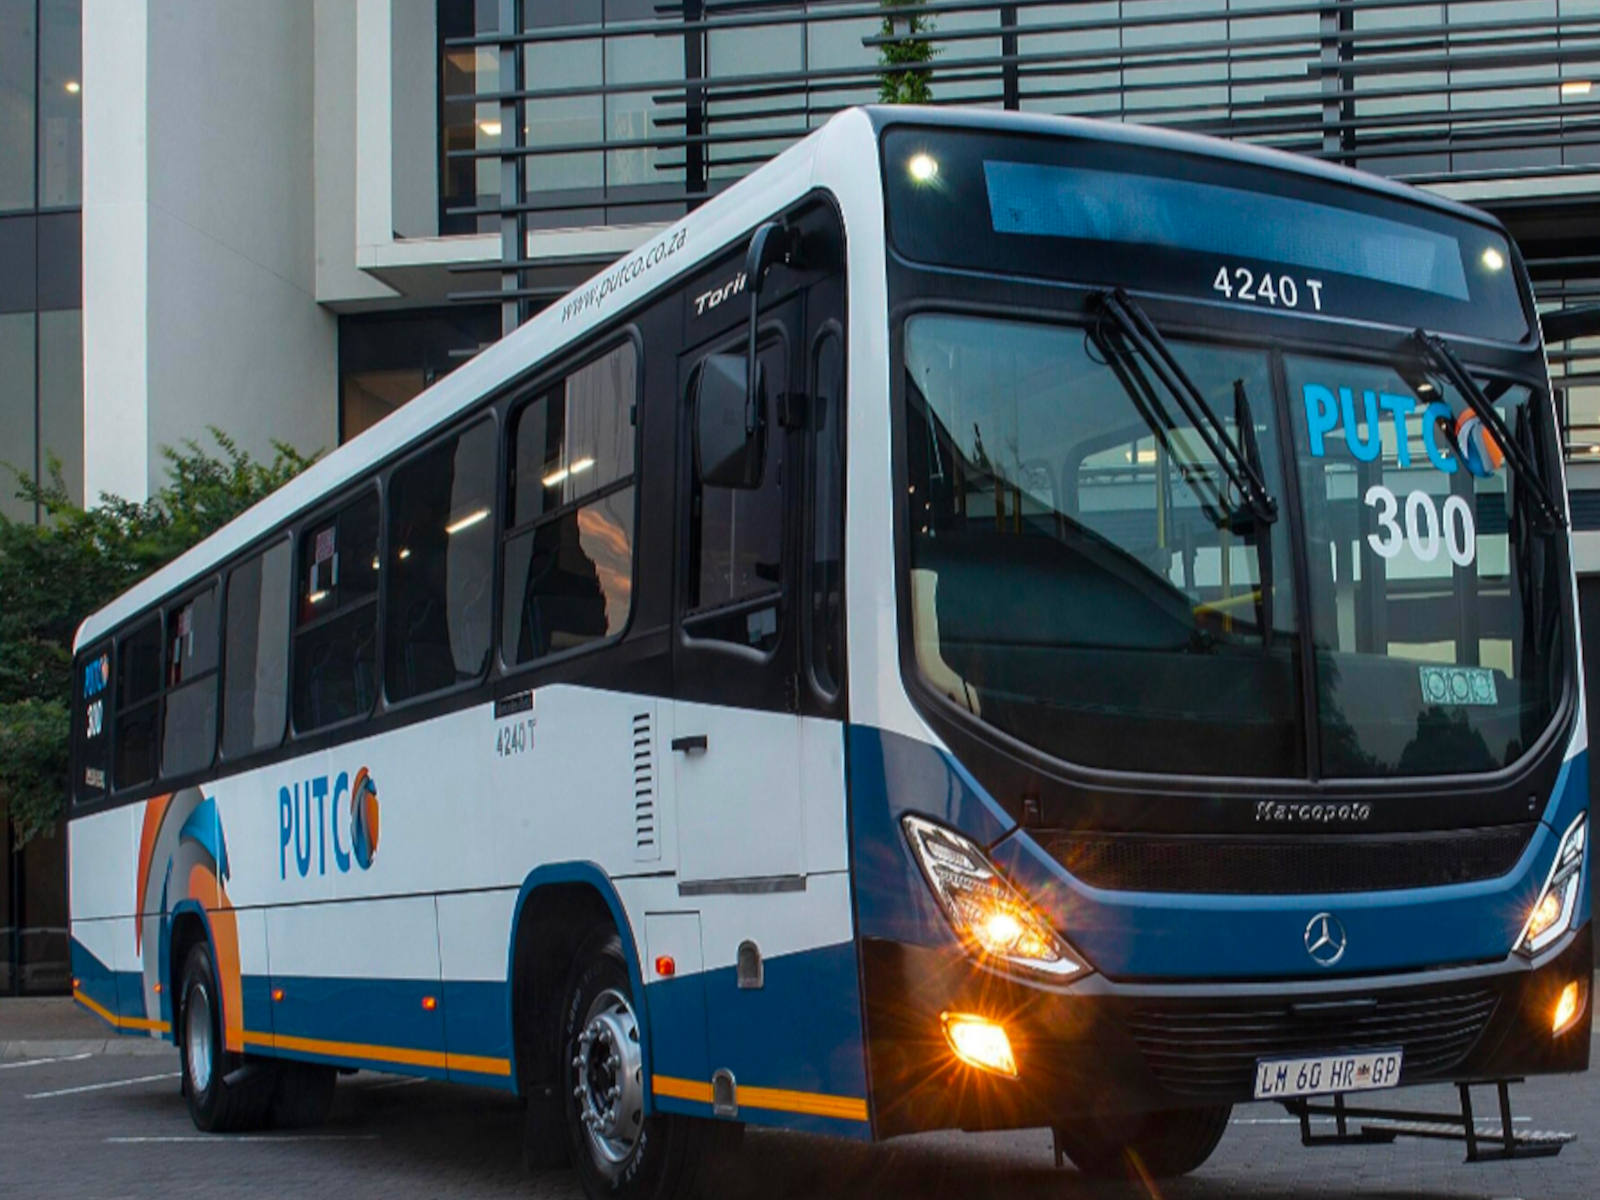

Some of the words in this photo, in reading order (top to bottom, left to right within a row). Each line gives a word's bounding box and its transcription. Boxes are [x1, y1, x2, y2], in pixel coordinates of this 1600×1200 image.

[562, 227, 687, 323] www.putco.co.za
[694, 266, 769, 315] Tori
[1213, 266, 1298, 308] 4240
[1306, 279, 1323, 311] T
[1364, 485, 1475, 567] 300
[496, 722, 526, 757] 4240
[528, 718, 537, 750] T
[279, 766, 379, 880] PUTCO
[1256, 801, 1371, 822] Marcopolo
[1262, 1064, 1287, 1092] LM
[1296, 1062, 1321, 1089] 60
[1330, 1059, 1355, 1087] HR
[1372, 1057, 1396, 1084] GP
